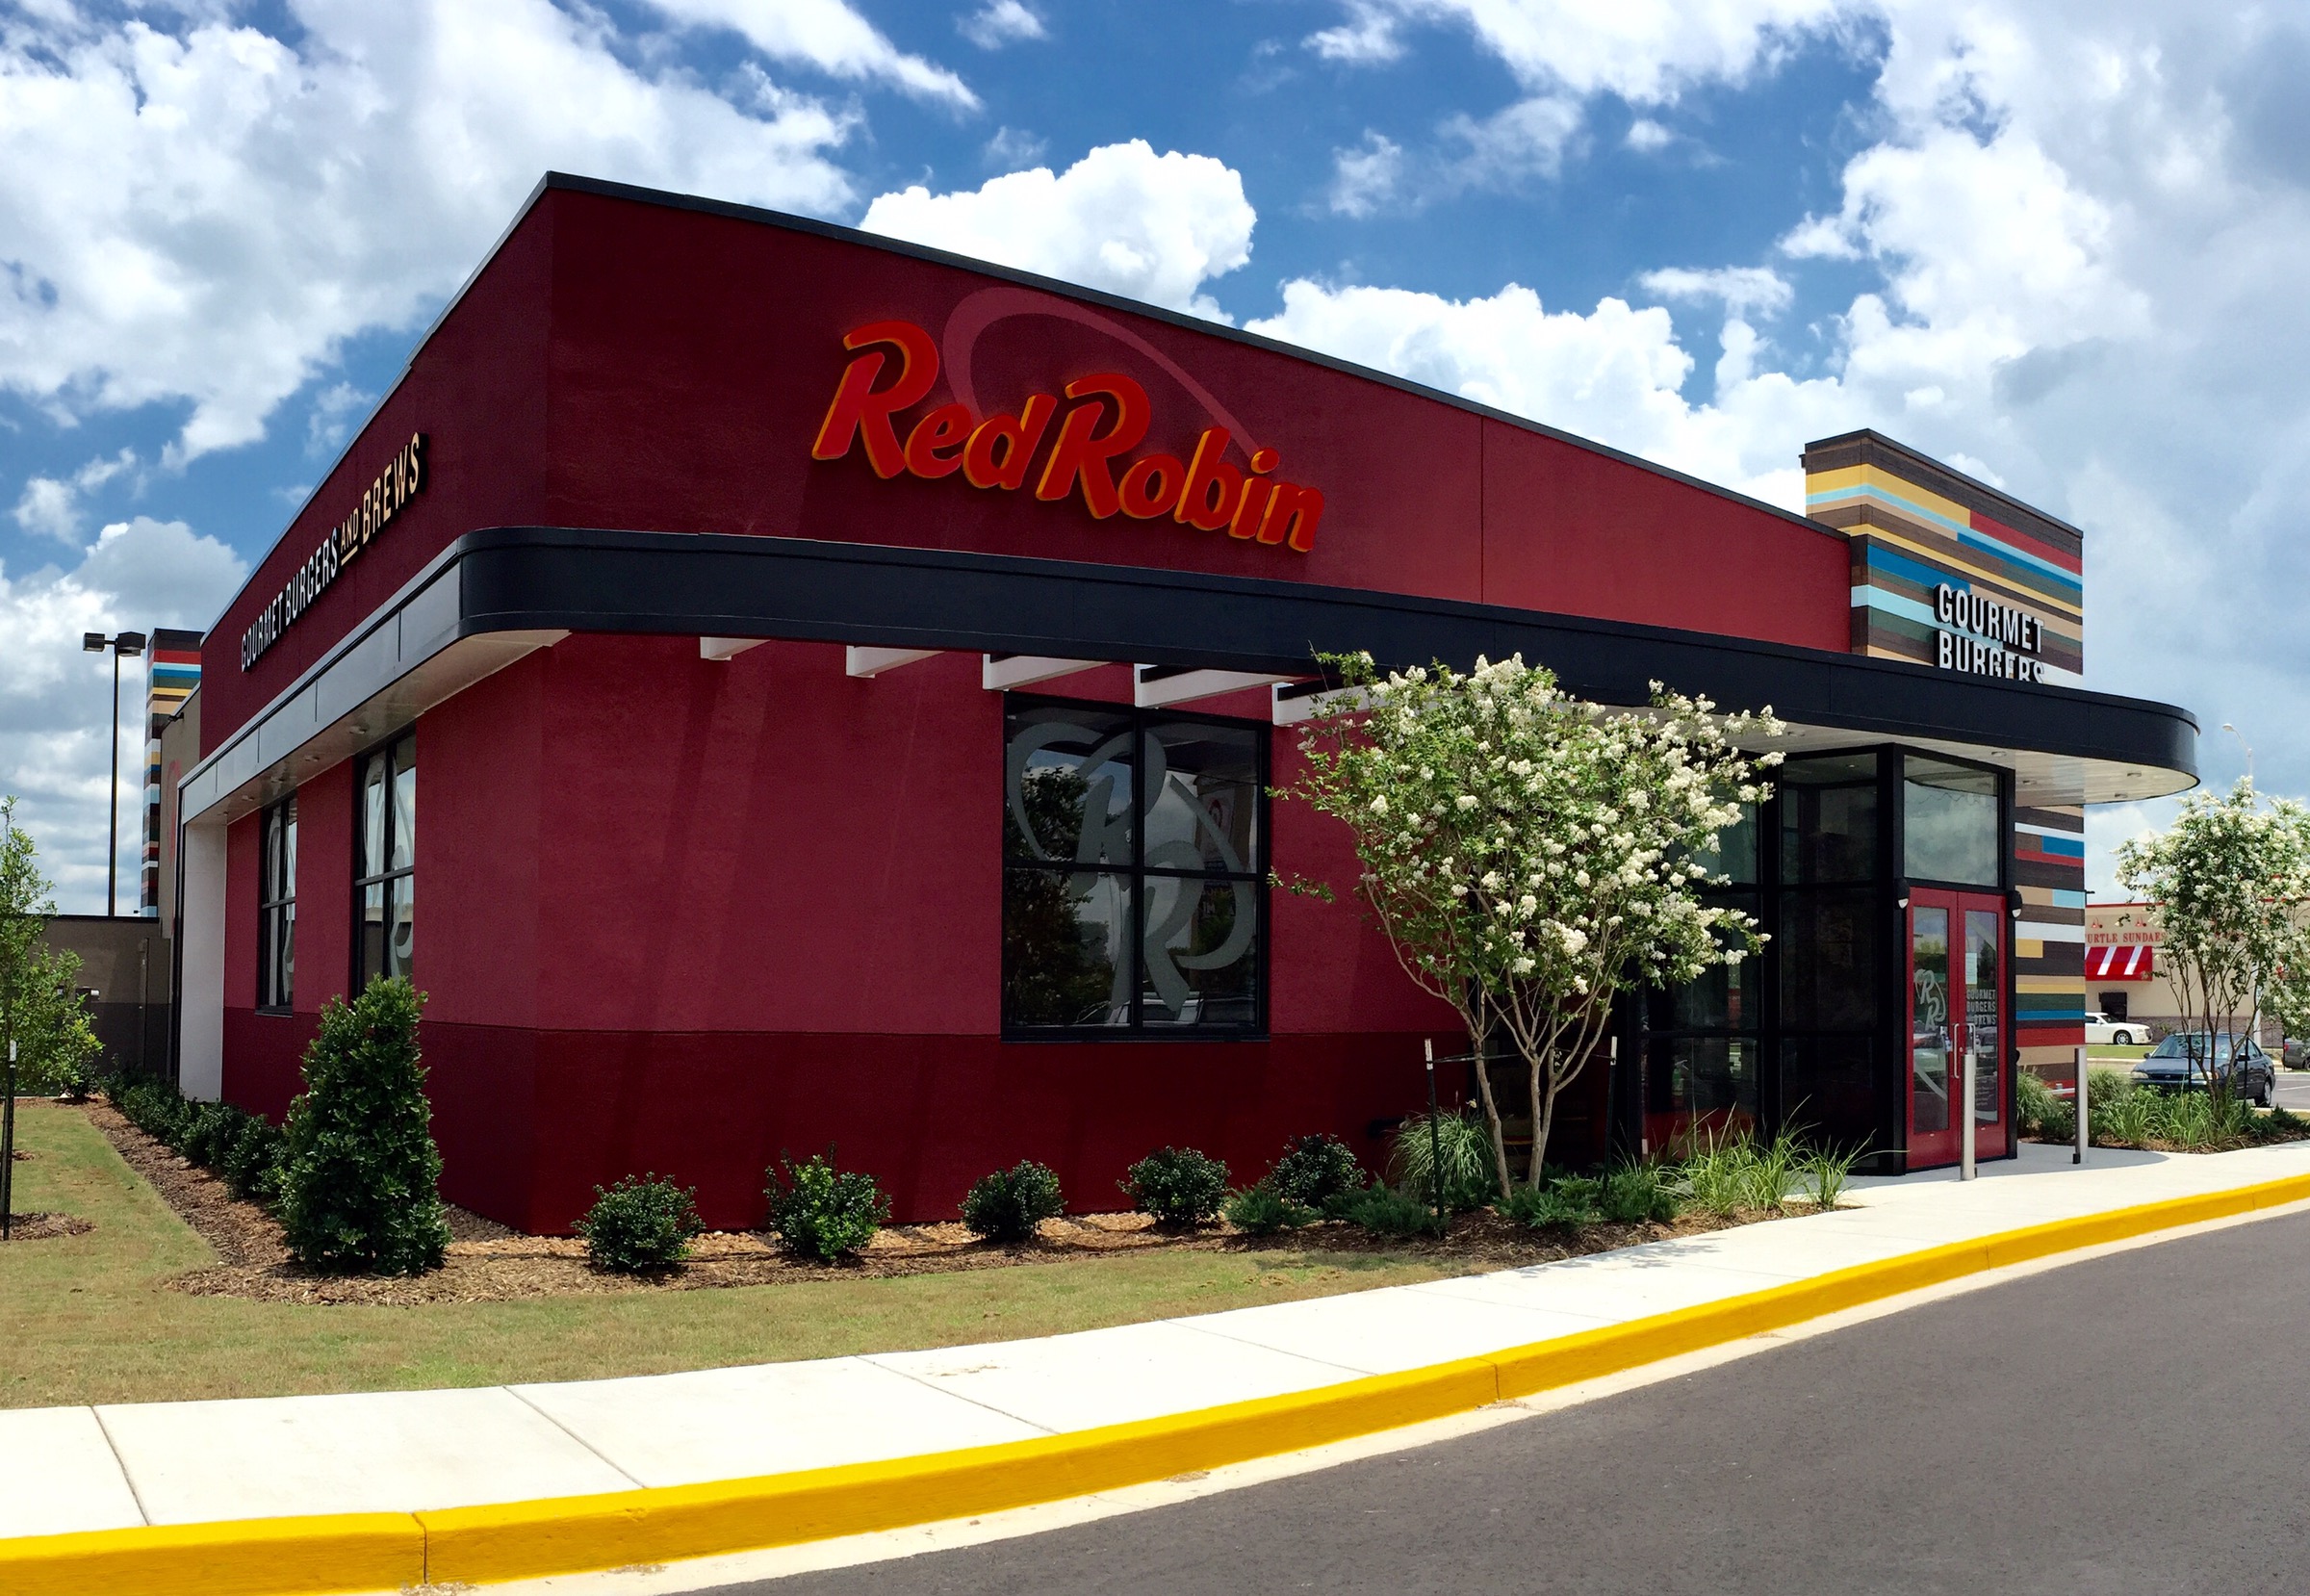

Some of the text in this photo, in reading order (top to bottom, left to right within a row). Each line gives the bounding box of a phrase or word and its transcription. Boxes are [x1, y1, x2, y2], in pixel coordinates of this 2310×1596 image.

[811, 320, 1326, 553] Red Robin
[241, 431, 421, 673] GOURMET BURGERS AND BREWS
[1938, 582, 2044, 654] GOURMET
[2086, 933, 2118, 944] URTLE
